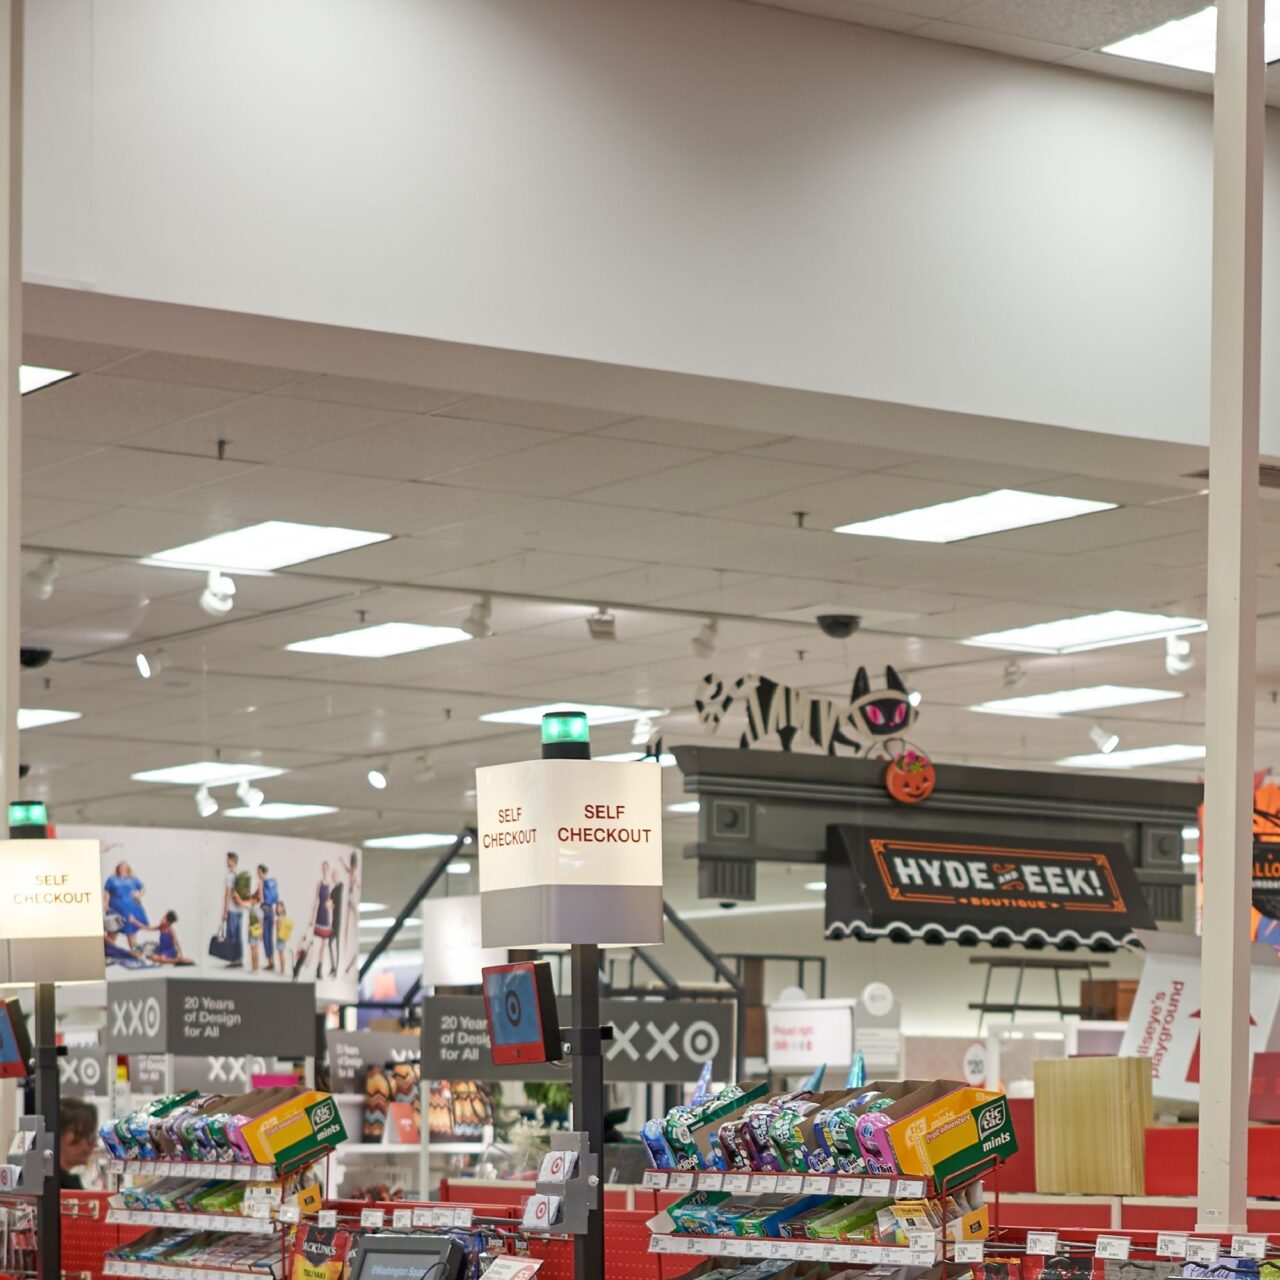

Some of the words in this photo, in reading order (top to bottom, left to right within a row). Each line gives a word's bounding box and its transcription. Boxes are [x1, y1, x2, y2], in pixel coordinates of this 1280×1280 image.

[498, 807, 522, 823] SELF
[584, 804, 626, 820] SELF
[483, 828, 537, 849] CHECKOUT
[557, 827, 652, 843] CHECKOUT
[35, 874, 69, 886] SELF
[892, 856, 995, 891] HYDE
[998, 871, 1019, 884] AND
[1021, 864, 1104, 897] EEK!
[13, 892, 92, 905] CHECKOUT
[971, 896, 1047, 909] BOUTIQUE
[184, 996, 199, 1010] 20
[202, 996, 235, 1010] Years
[184, 1010, 197, 1024] of
[199, 1010, 241, 1026] Design
[441, 1016, 458, 1029] 20
[460, 1016, 488, 1029] Year
[1137, 991, 1167, 1057] llseye's
[184, 1025, 200, 1037] for
[202, 1025, 220, 1038] All
[441, 1031, 455, 1045] of
[457, 1032, 491, 1048] Desig
[441, 1048, 459, 1060] for
[462, 1048, 479, 1060] All
[982, 1116, 1002, 1130] tac
[984, 1108, 1002, 1122] tic
[317, 1124, 340, 1141] mints
[982, 1131, 1011, 1152] mints
[866, 1158, 895, 1175] Orbit
